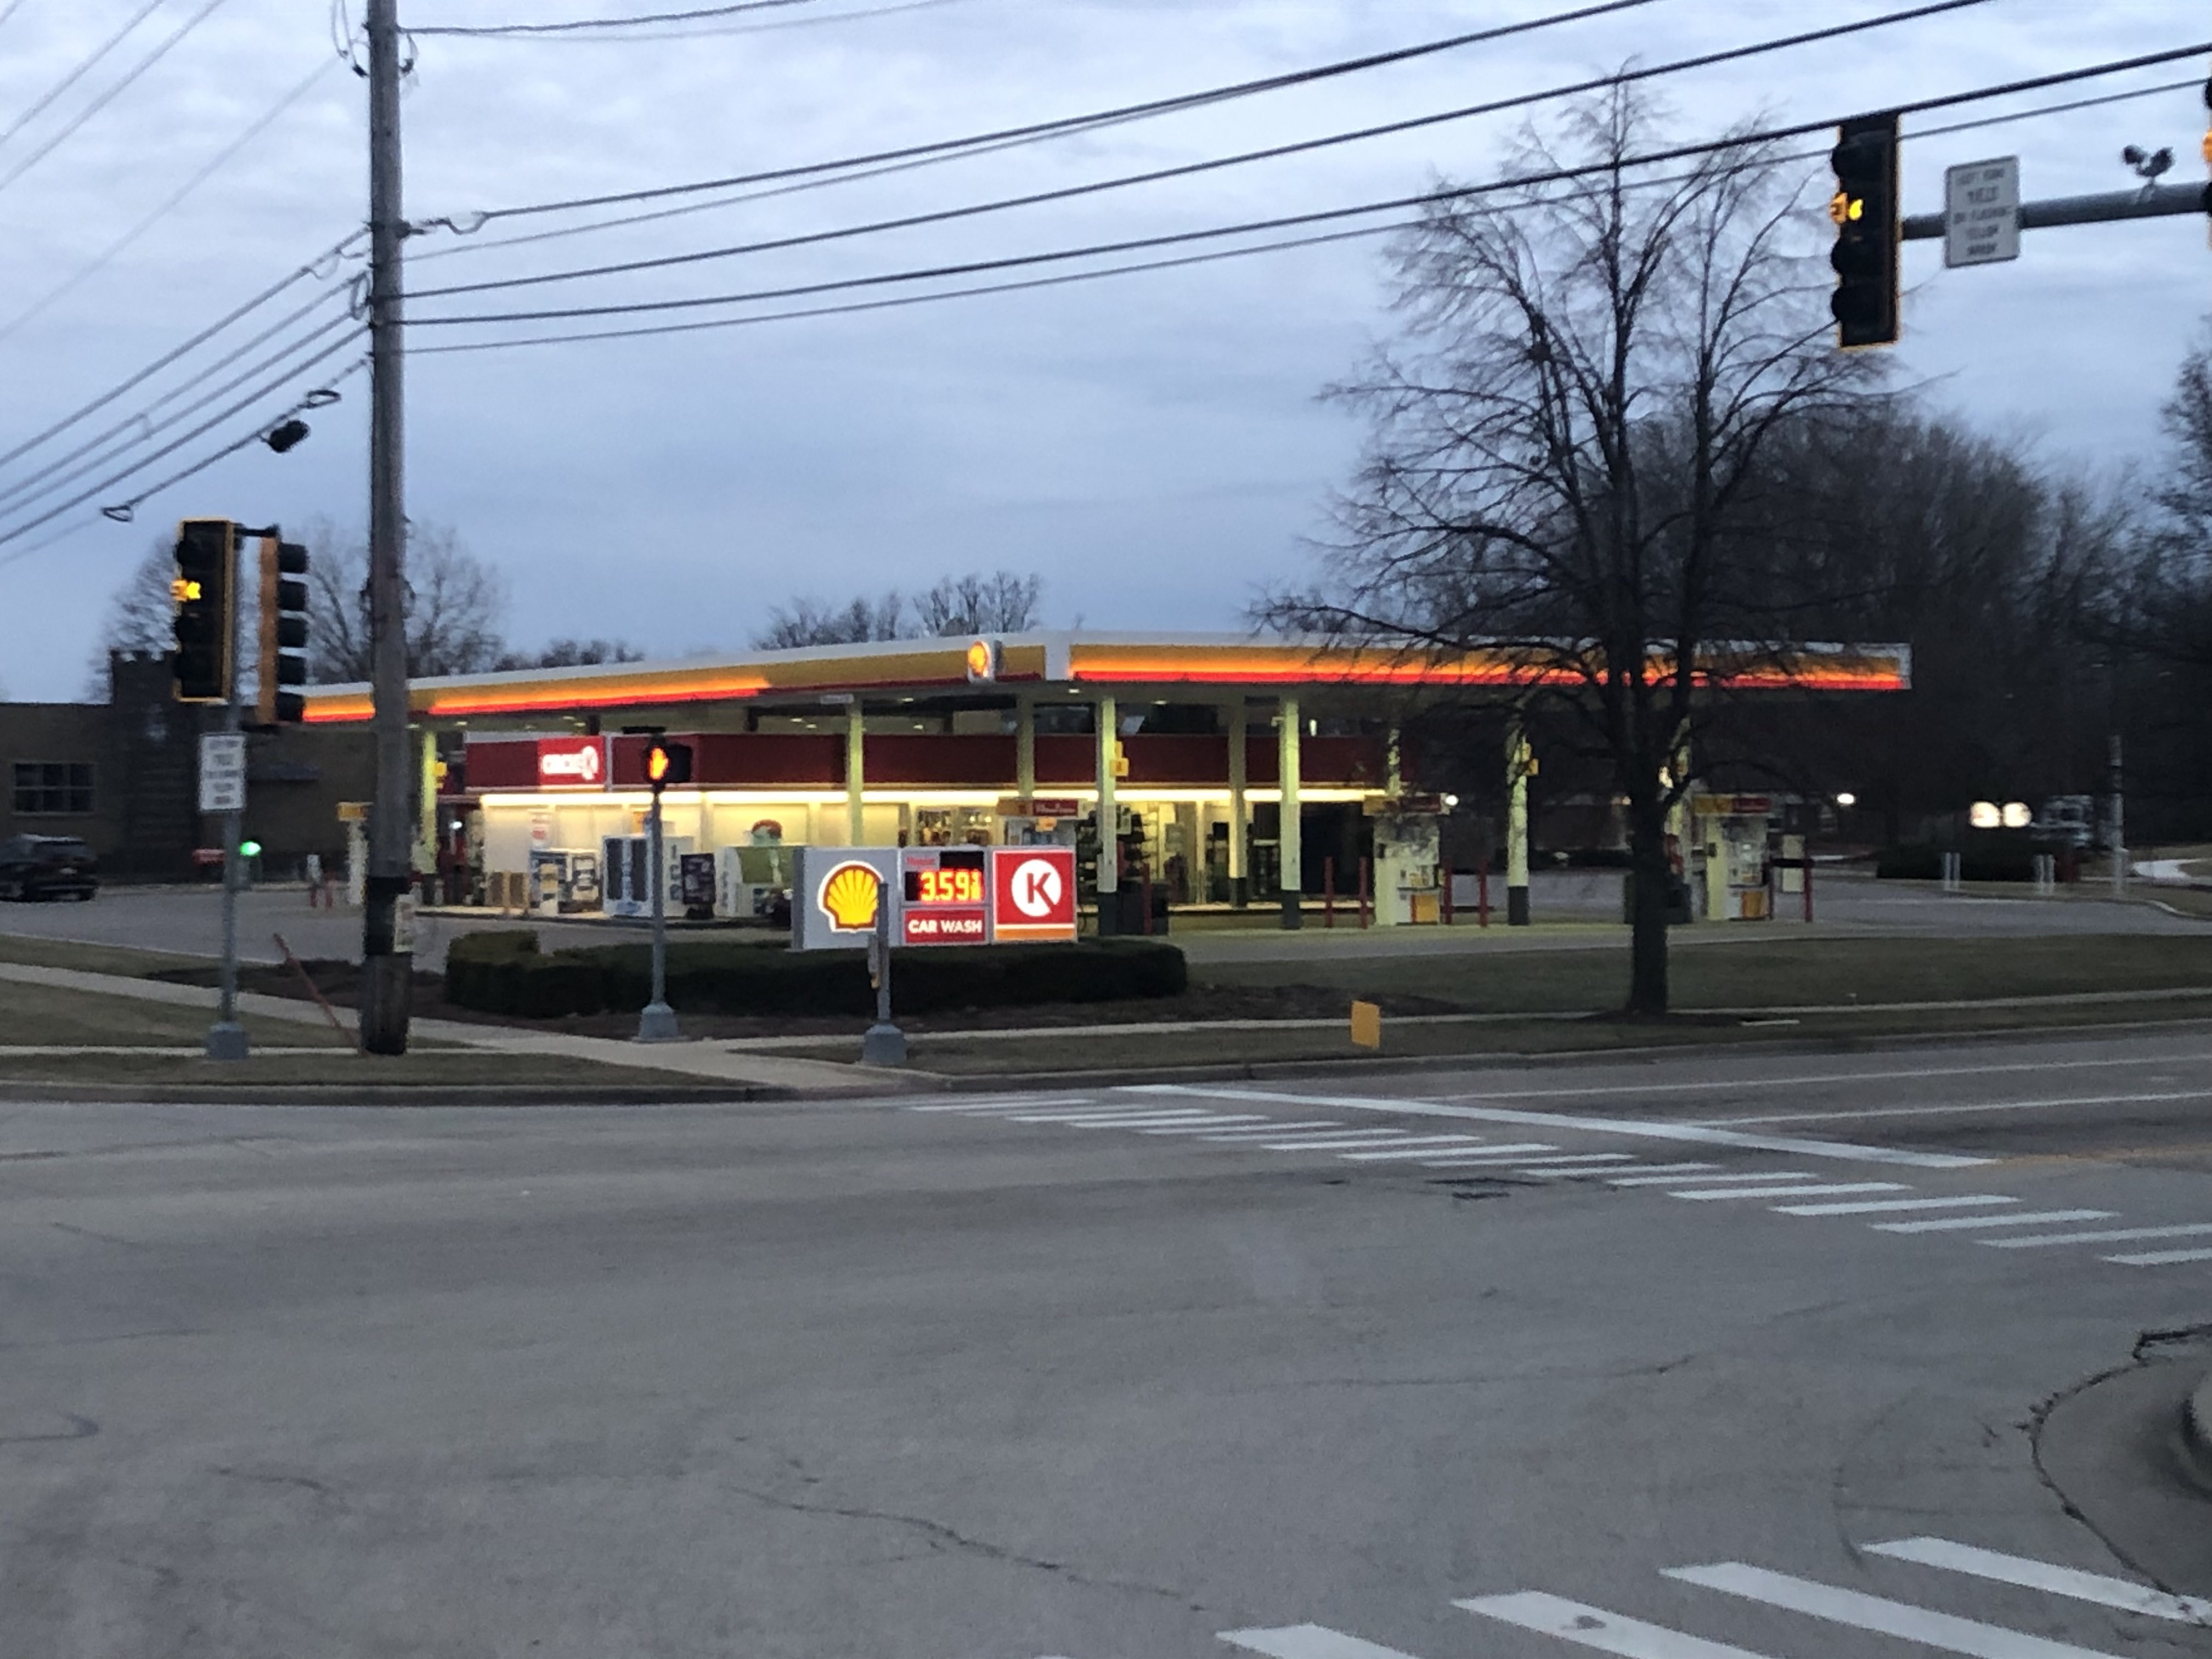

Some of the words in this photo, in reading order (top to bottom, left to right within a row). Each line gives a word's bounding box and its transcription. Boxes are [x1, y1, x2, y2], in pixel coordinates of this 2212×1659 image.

[1026, 871, 1054, 911] K
[908, 919, 938, 933] CAR
[940, 919, 983, 933] WASH
